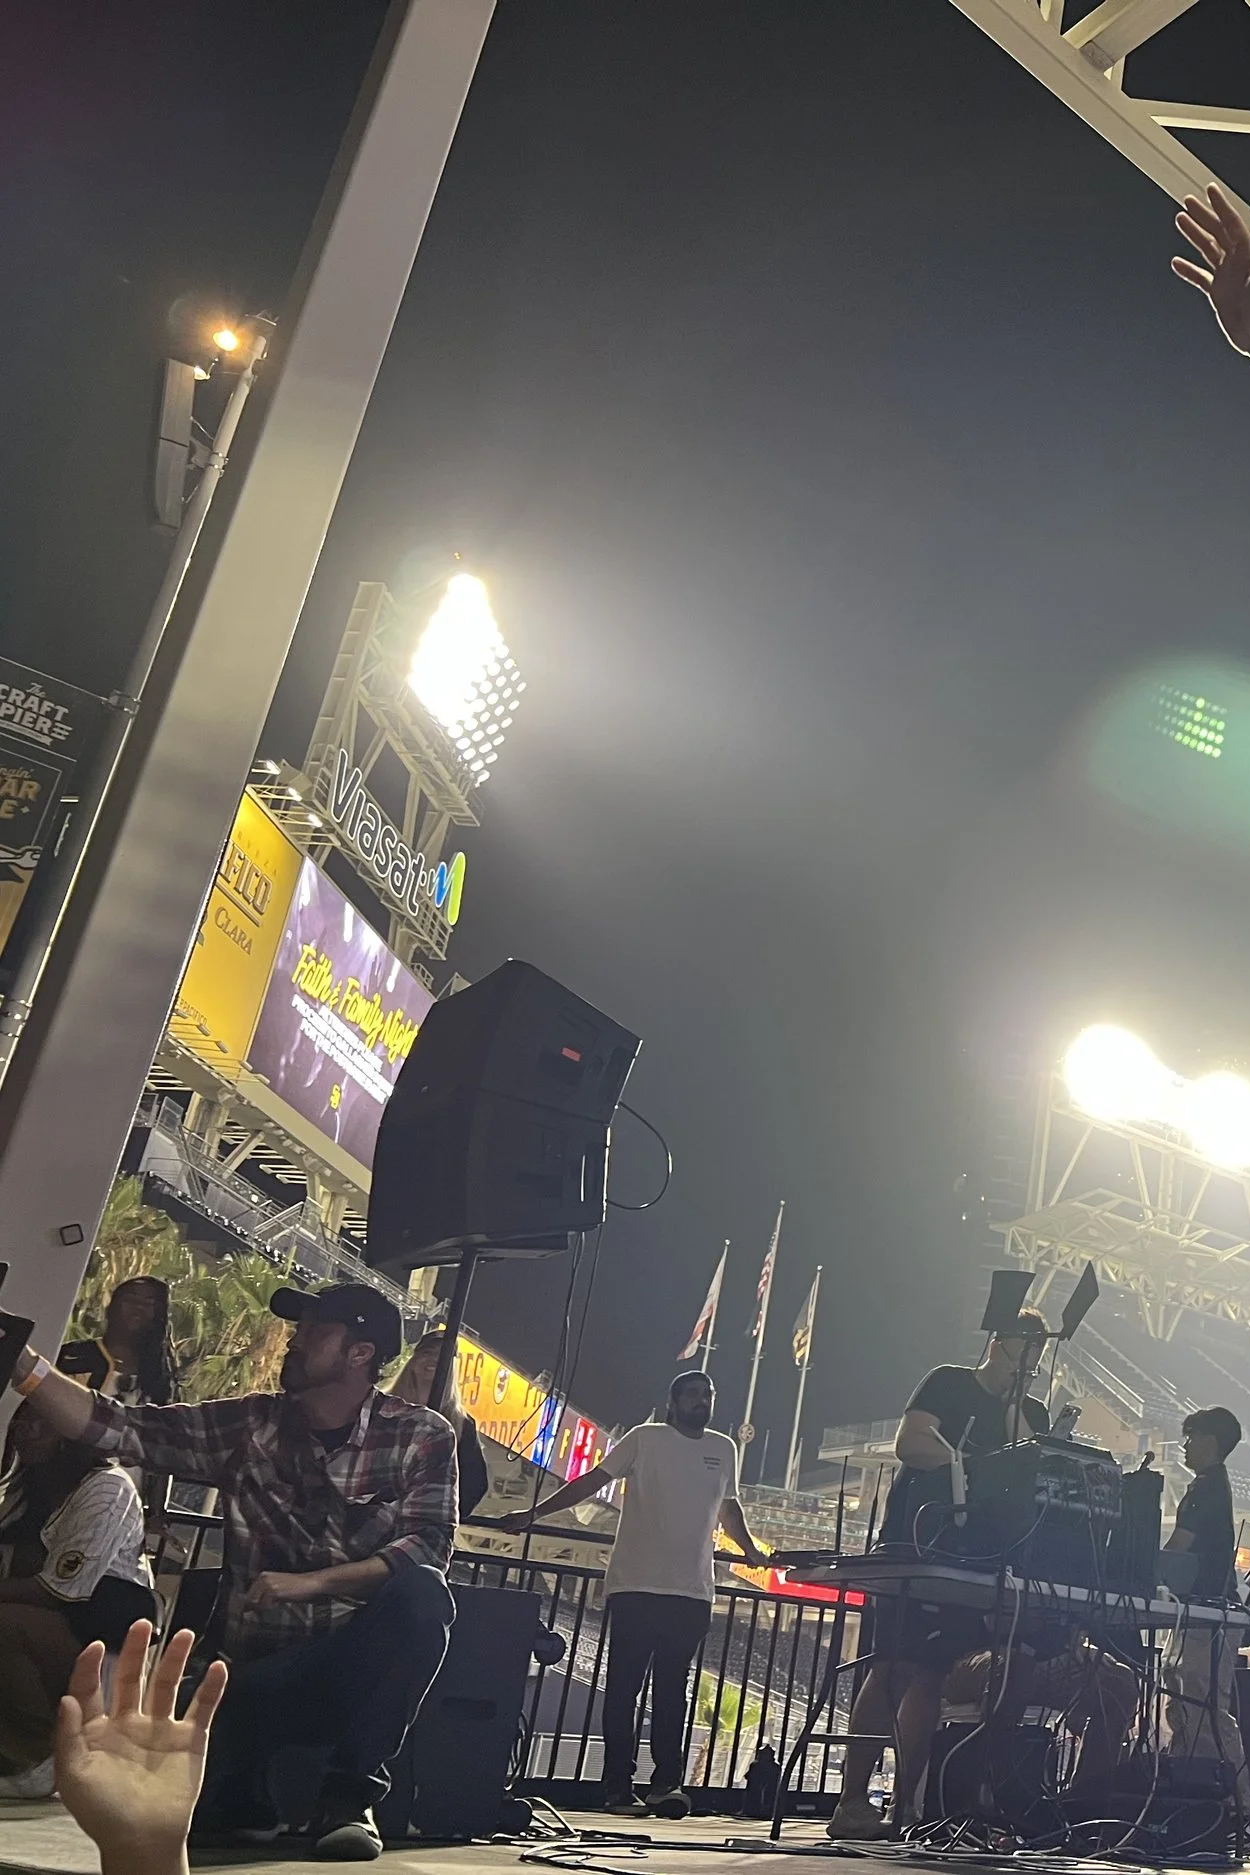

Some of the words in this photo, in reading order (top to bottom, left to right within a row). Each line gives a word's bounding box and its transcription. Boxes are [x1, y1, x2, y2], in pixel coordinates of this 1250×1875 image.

[0, 684, 69, 721] CRAFT
[0, 702, 53, 735] PIER
[332, 749, 426, 916] Viasat
[214, 906, 252, 956] CLARA
[291, 944, 333, 1003] Faith
[338, 976, 384, 1051] Family
